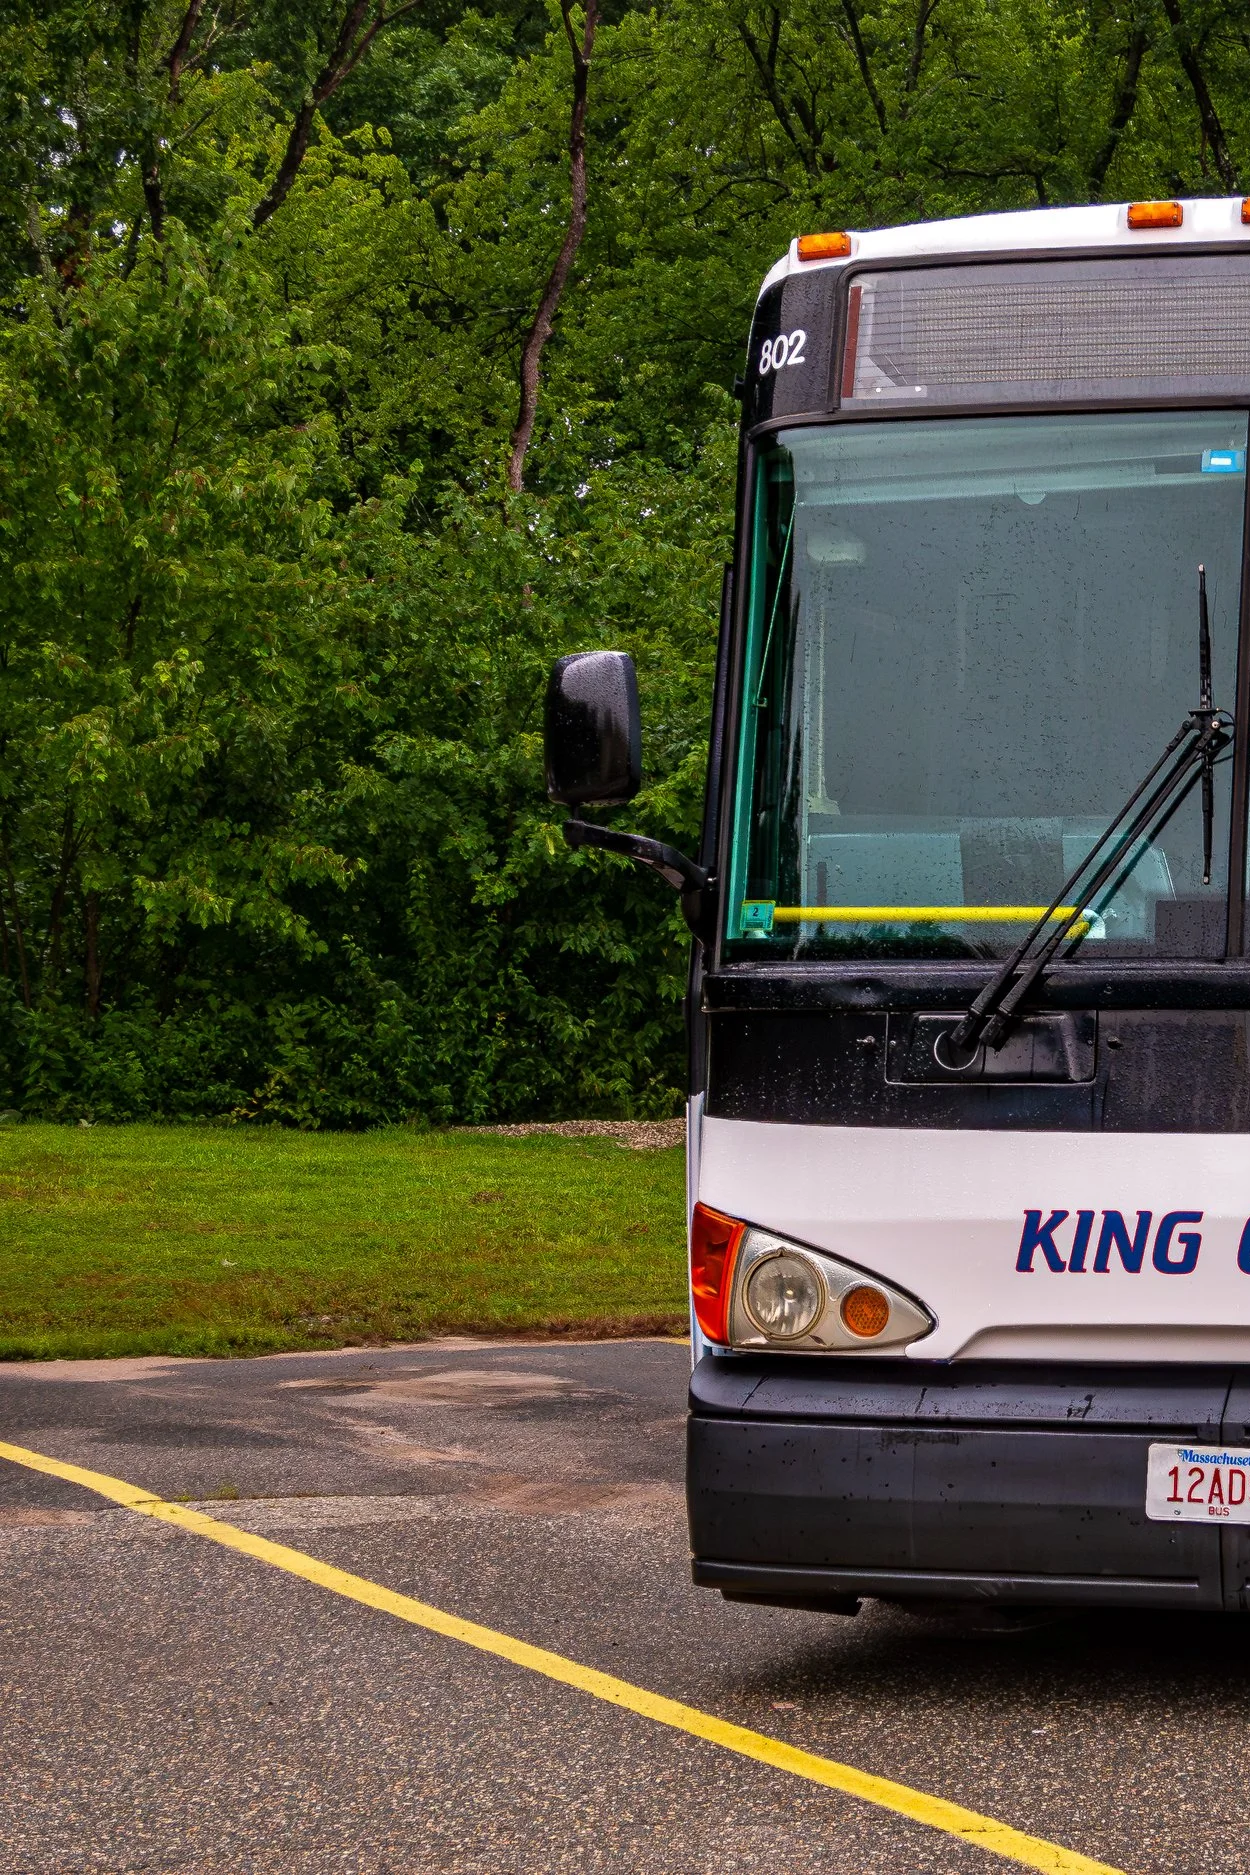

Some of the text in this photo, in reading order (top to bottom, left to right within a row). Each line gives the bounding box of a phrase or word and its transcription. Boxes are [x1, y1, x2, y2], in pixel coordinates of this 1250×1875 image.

[758, 329, 807, 375] 802
[752, 907, 759, 917] 2
[1015, 1210, 1204, 1275] KING
[1208, 1506, 1231, 1517] BUS
